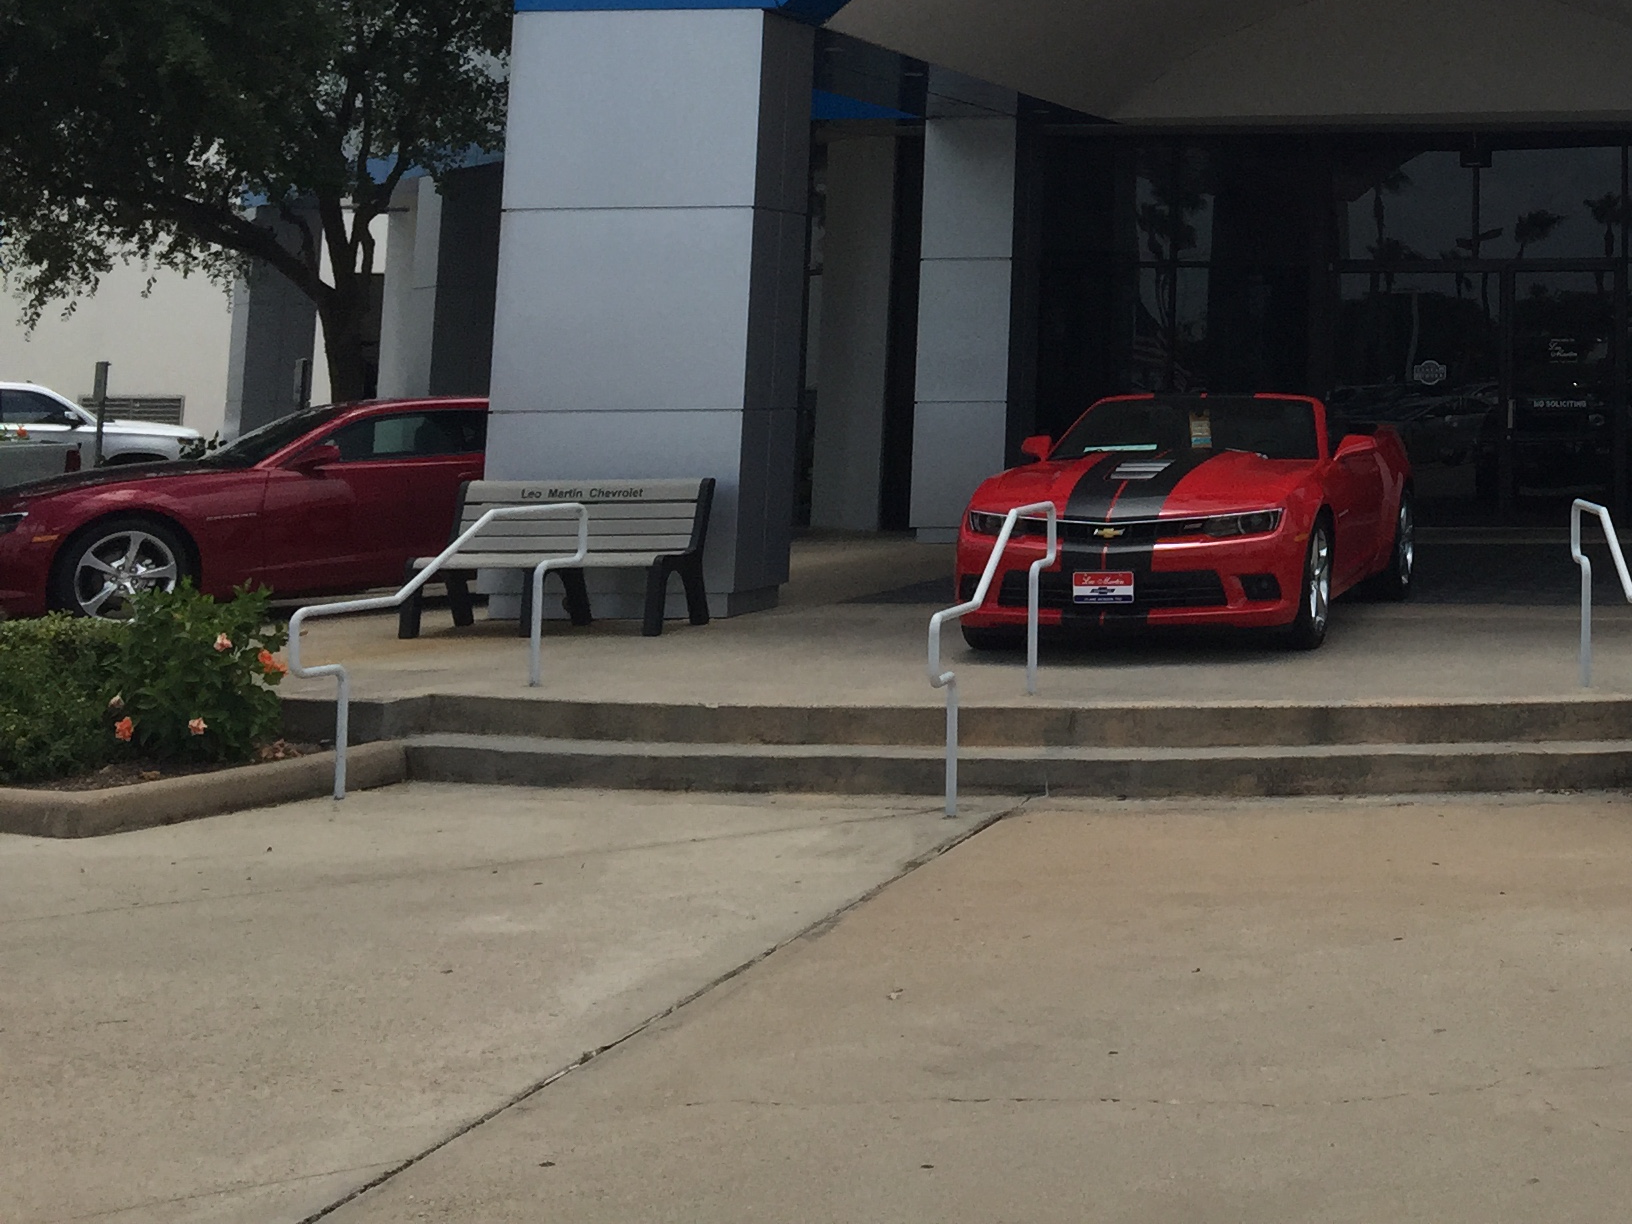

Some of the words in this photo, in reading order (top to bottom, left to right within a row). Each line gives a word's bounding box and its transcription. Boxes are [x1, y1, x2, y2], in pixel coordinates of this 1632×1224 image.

[521, 489, 542, 499] Leo
[548, 488, 583, 499] Martin
[589, 487, 643, 498] Chevrolet
